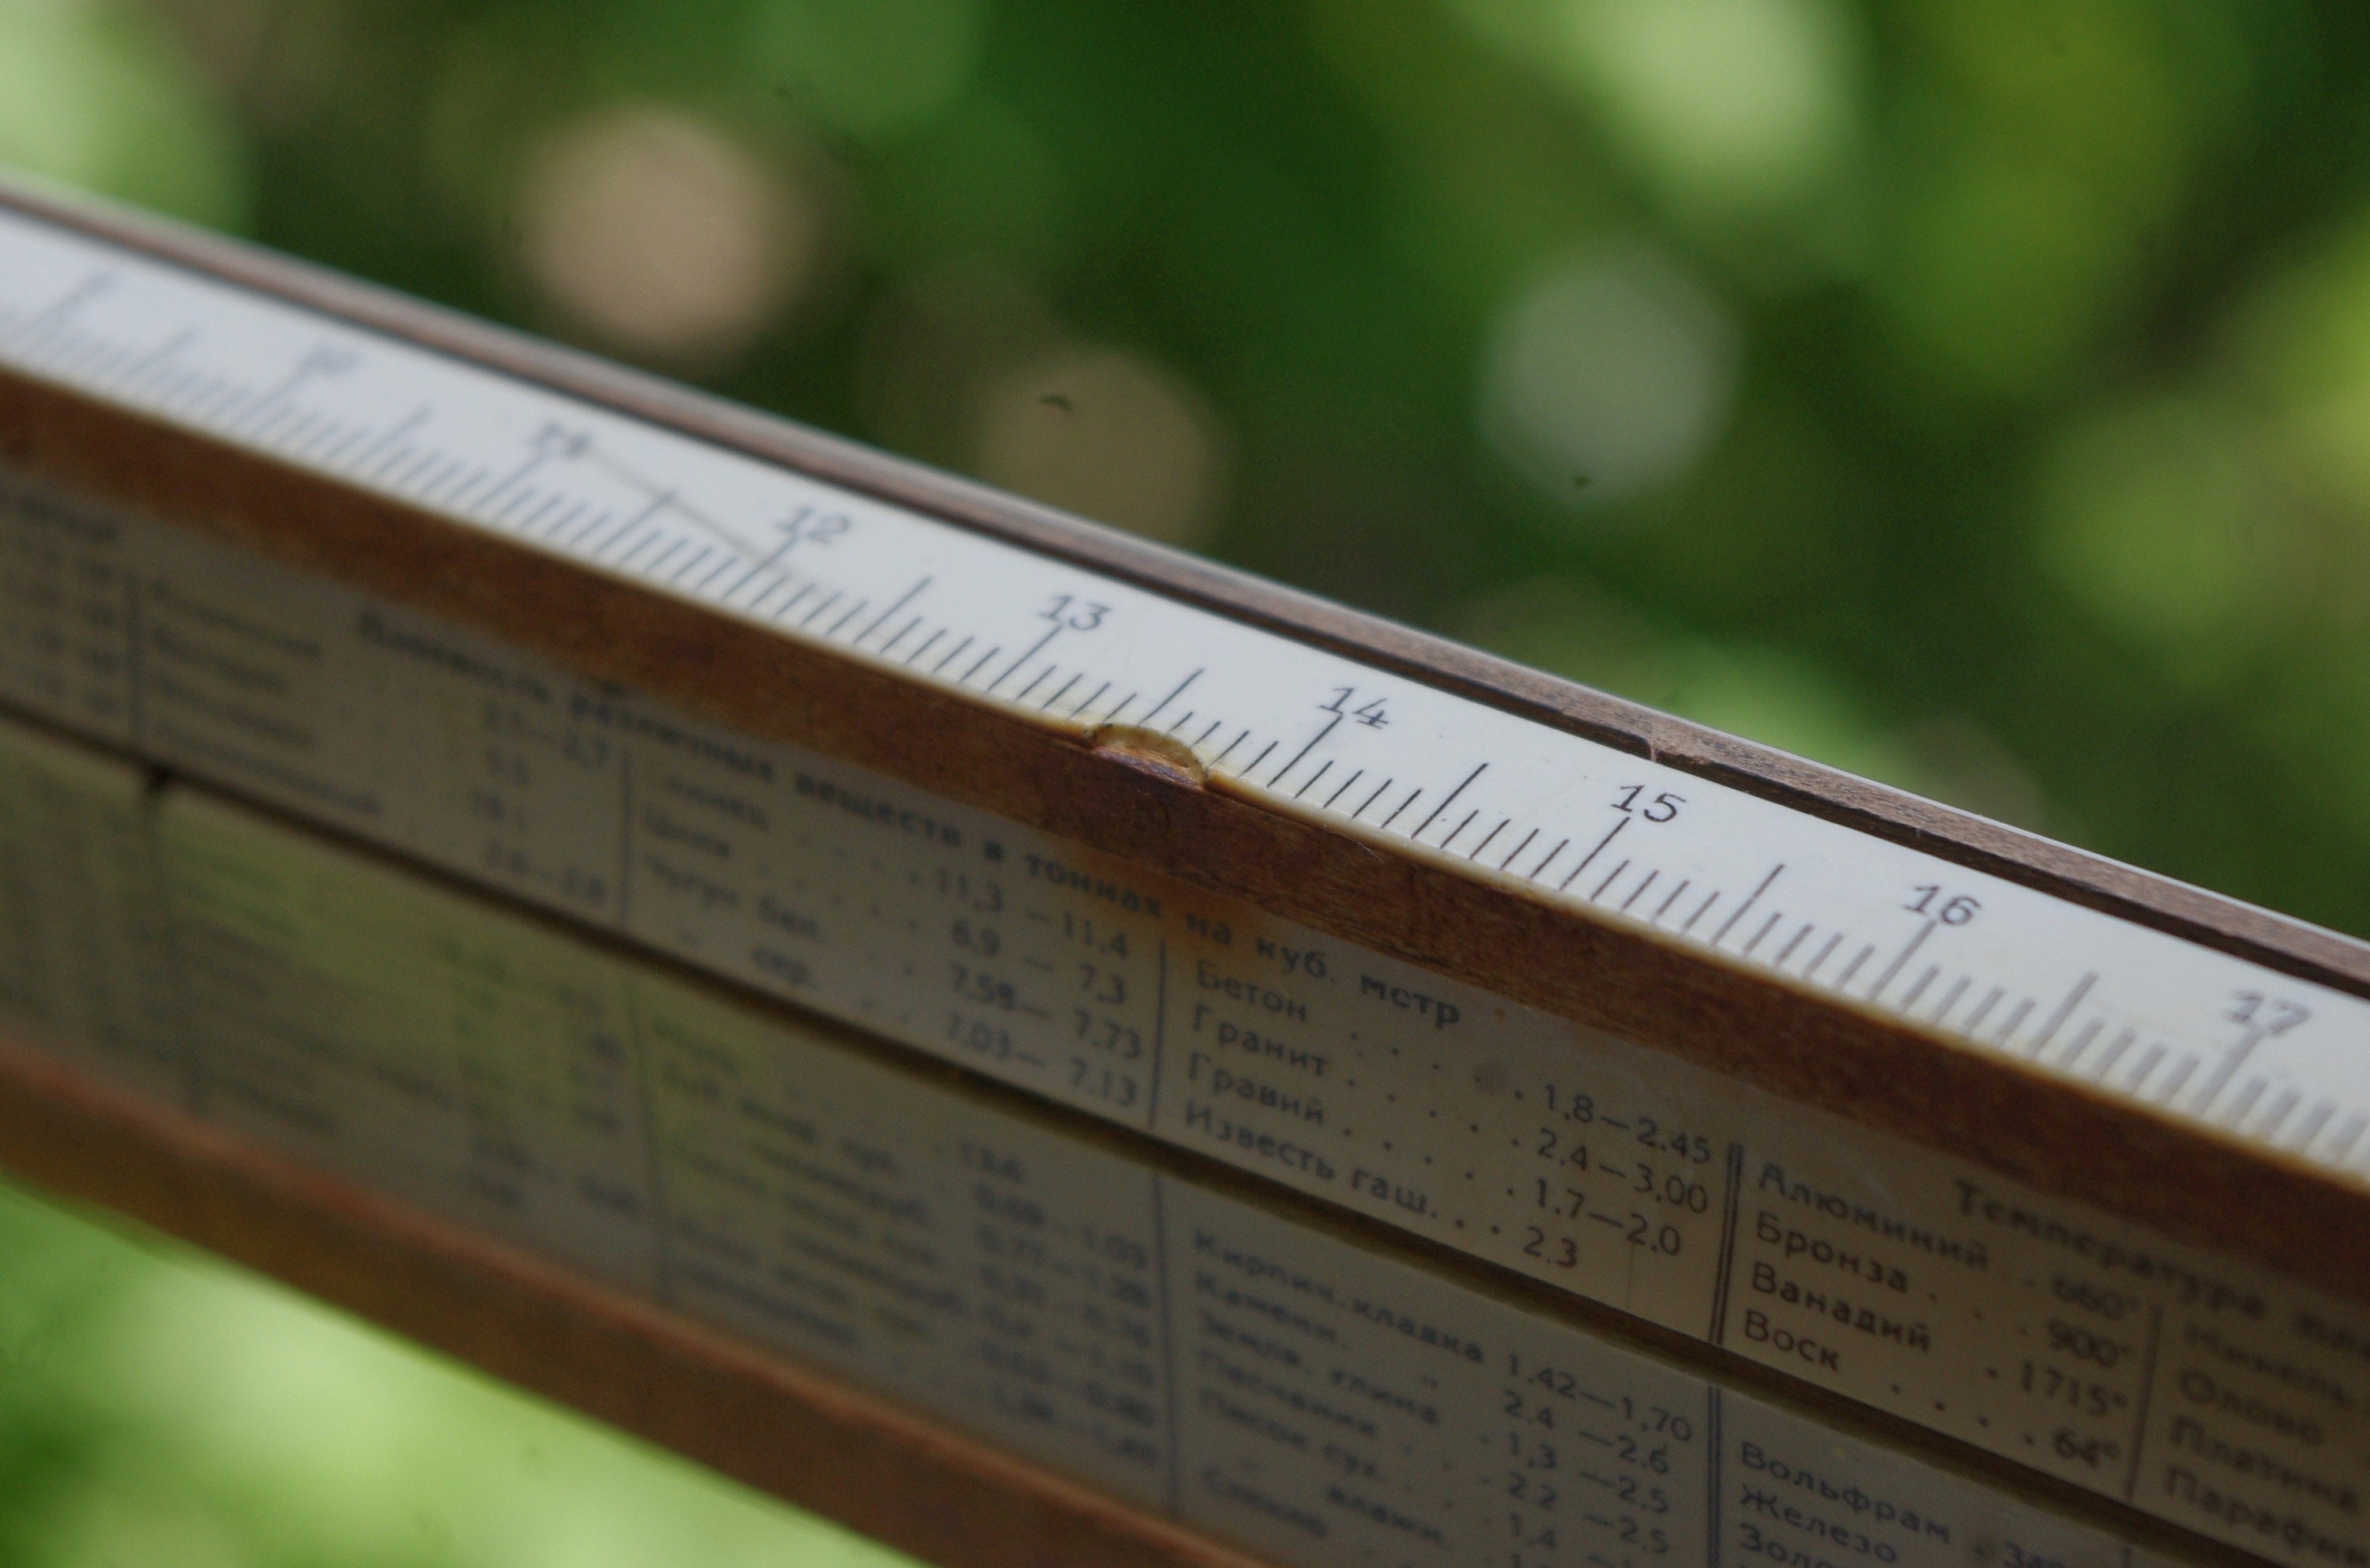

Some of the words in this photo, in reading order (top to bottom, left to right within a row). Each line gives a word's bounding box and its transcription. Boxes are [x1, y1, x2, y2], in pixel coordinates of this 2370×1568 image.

[775, 506, 852, 543] 12
[1038, 594, 1113, 632] 13
[1317, 686, 1389, 729] 14
[1610, 784, 1687, 823] 15
[1025, 853, 1162, 918] тоннах
[1185, 912, 1233, 946] на
[1902, 884, 1981, 927] 16
[1197, 958, 1307, 1022] Бетон
[2225, 988, 2312, 1036] 17
[1194, 1003, 1329, 1077] Гранит
[1189, 1051, 1325, 1126] Гравий
[1185, 1100, 1336, 1181] Известь
[1523, 1225, 1578, 1269] 2.3
[1759, 1162, 1989, 1273] Алюминий
[1757, 1210, 1909, 1295] Бронза
[1744, 1308, 1841, 1372] Воск
[1751, 1261, 1931, 1354] Ванадий
[1740, 1483, 1898, 1564] Железо
[1741, 1441, 1951, 1545] Вольфрам
